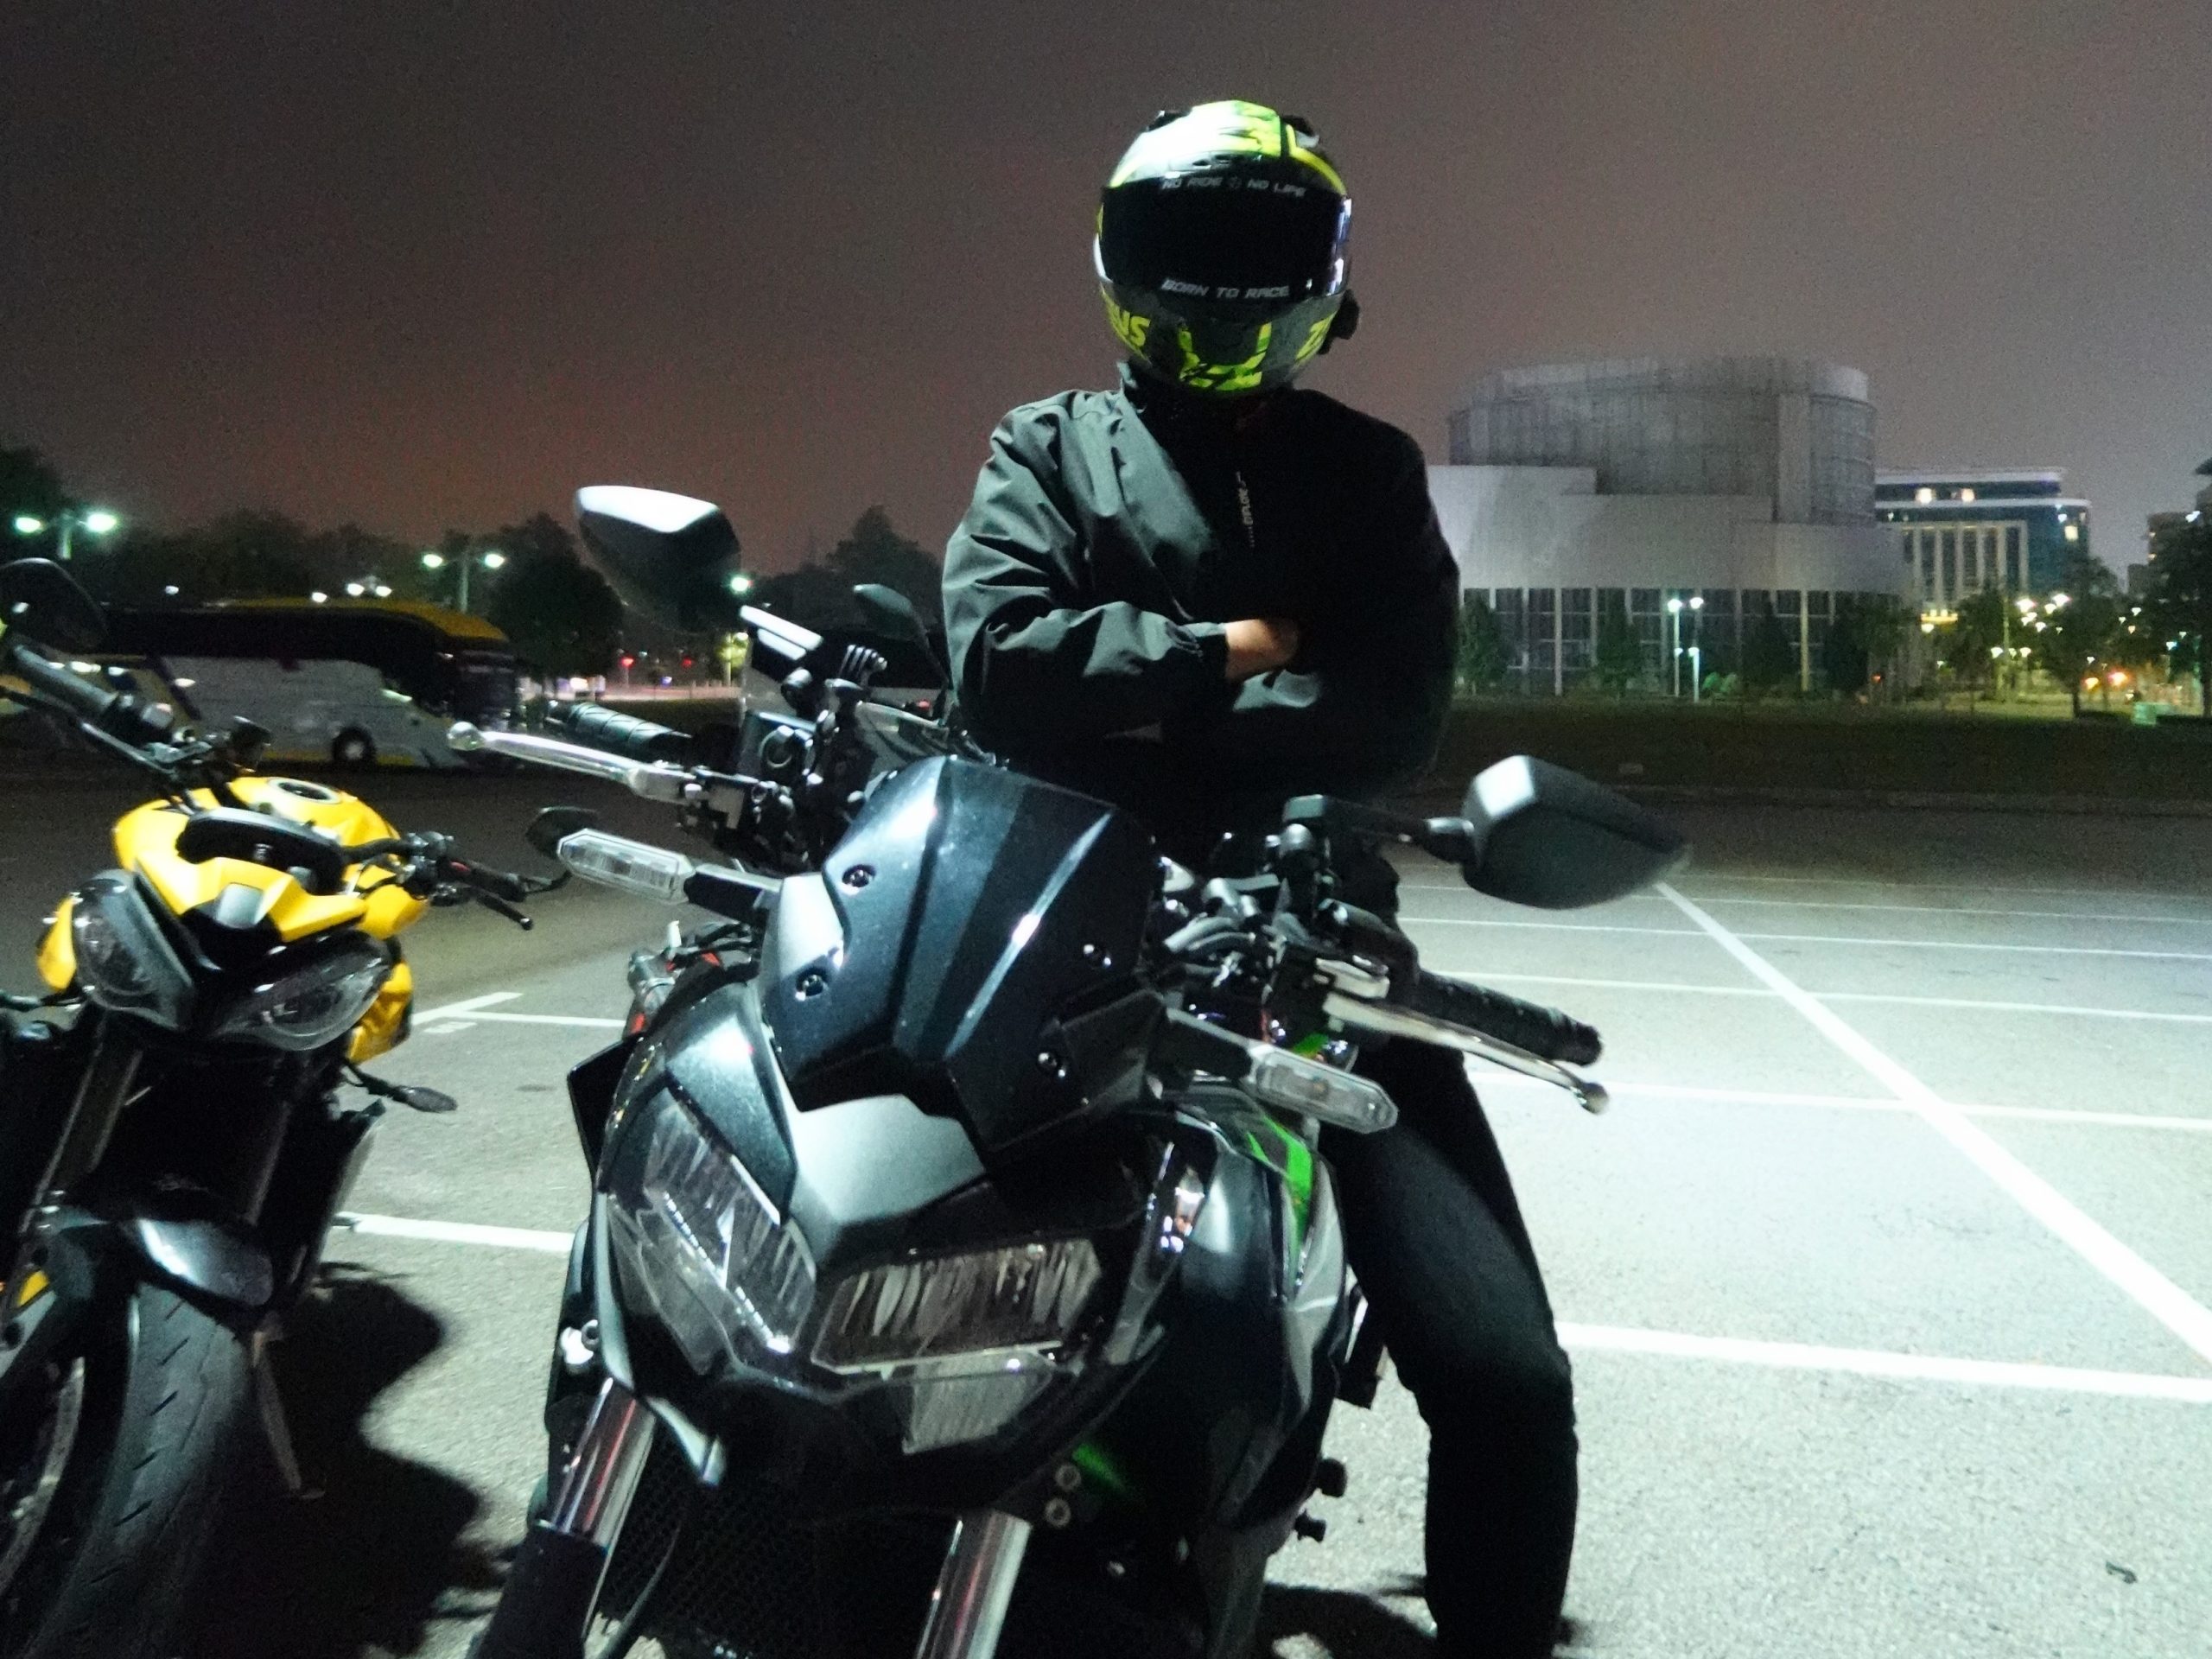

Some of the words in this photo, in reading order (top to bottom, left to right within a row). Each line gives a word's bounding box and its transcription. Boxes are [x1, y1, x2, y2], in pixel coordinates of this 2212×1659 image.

[1247, 179, 1270, 190] NO
[1160, 278, 1210, 296] BORN
[1217, 286, 1241, 299] TO
[1244, 285, 1290, 299] RACE
